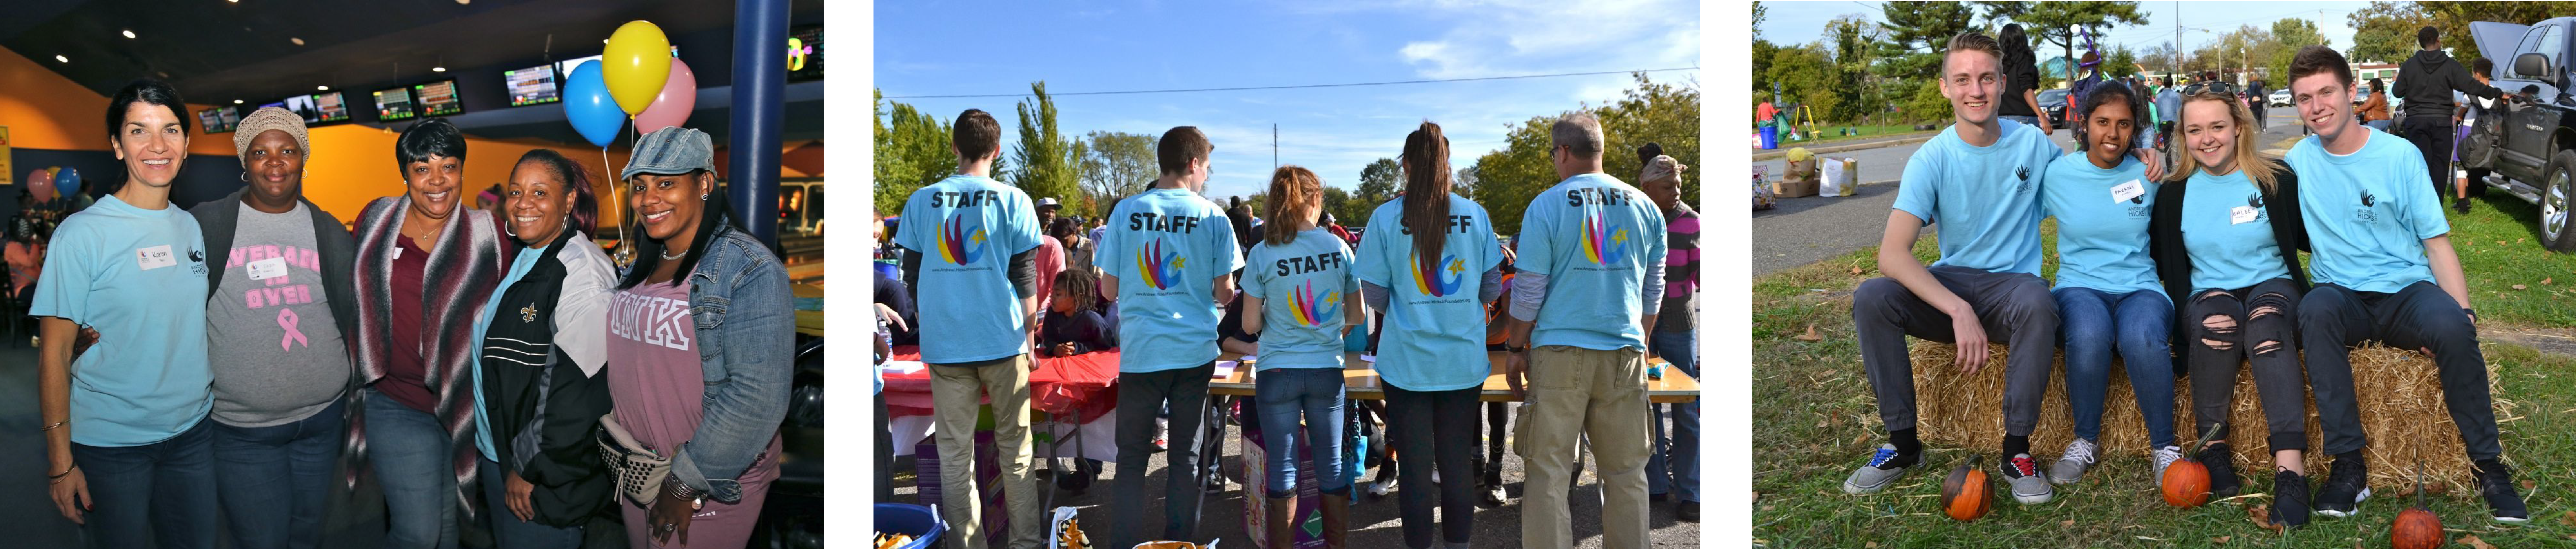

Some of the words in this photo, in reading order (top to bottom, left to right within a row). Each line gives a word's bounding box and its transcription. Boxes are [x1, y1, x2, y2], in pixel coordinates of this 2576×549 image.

[931, 190, 998, 208] STAFF
[1567, 187, 1634, 207] STAFF
[1130, 212, 1199, 234] STAFF
[1400, 215, 1472, 235] SFF
[2357, 213, 2374, 221] HICKS
[1276, 252, 1341, 277] STAFF
[245, 284, 312, 309] OVER
[607, 291, 690, 351] INK
